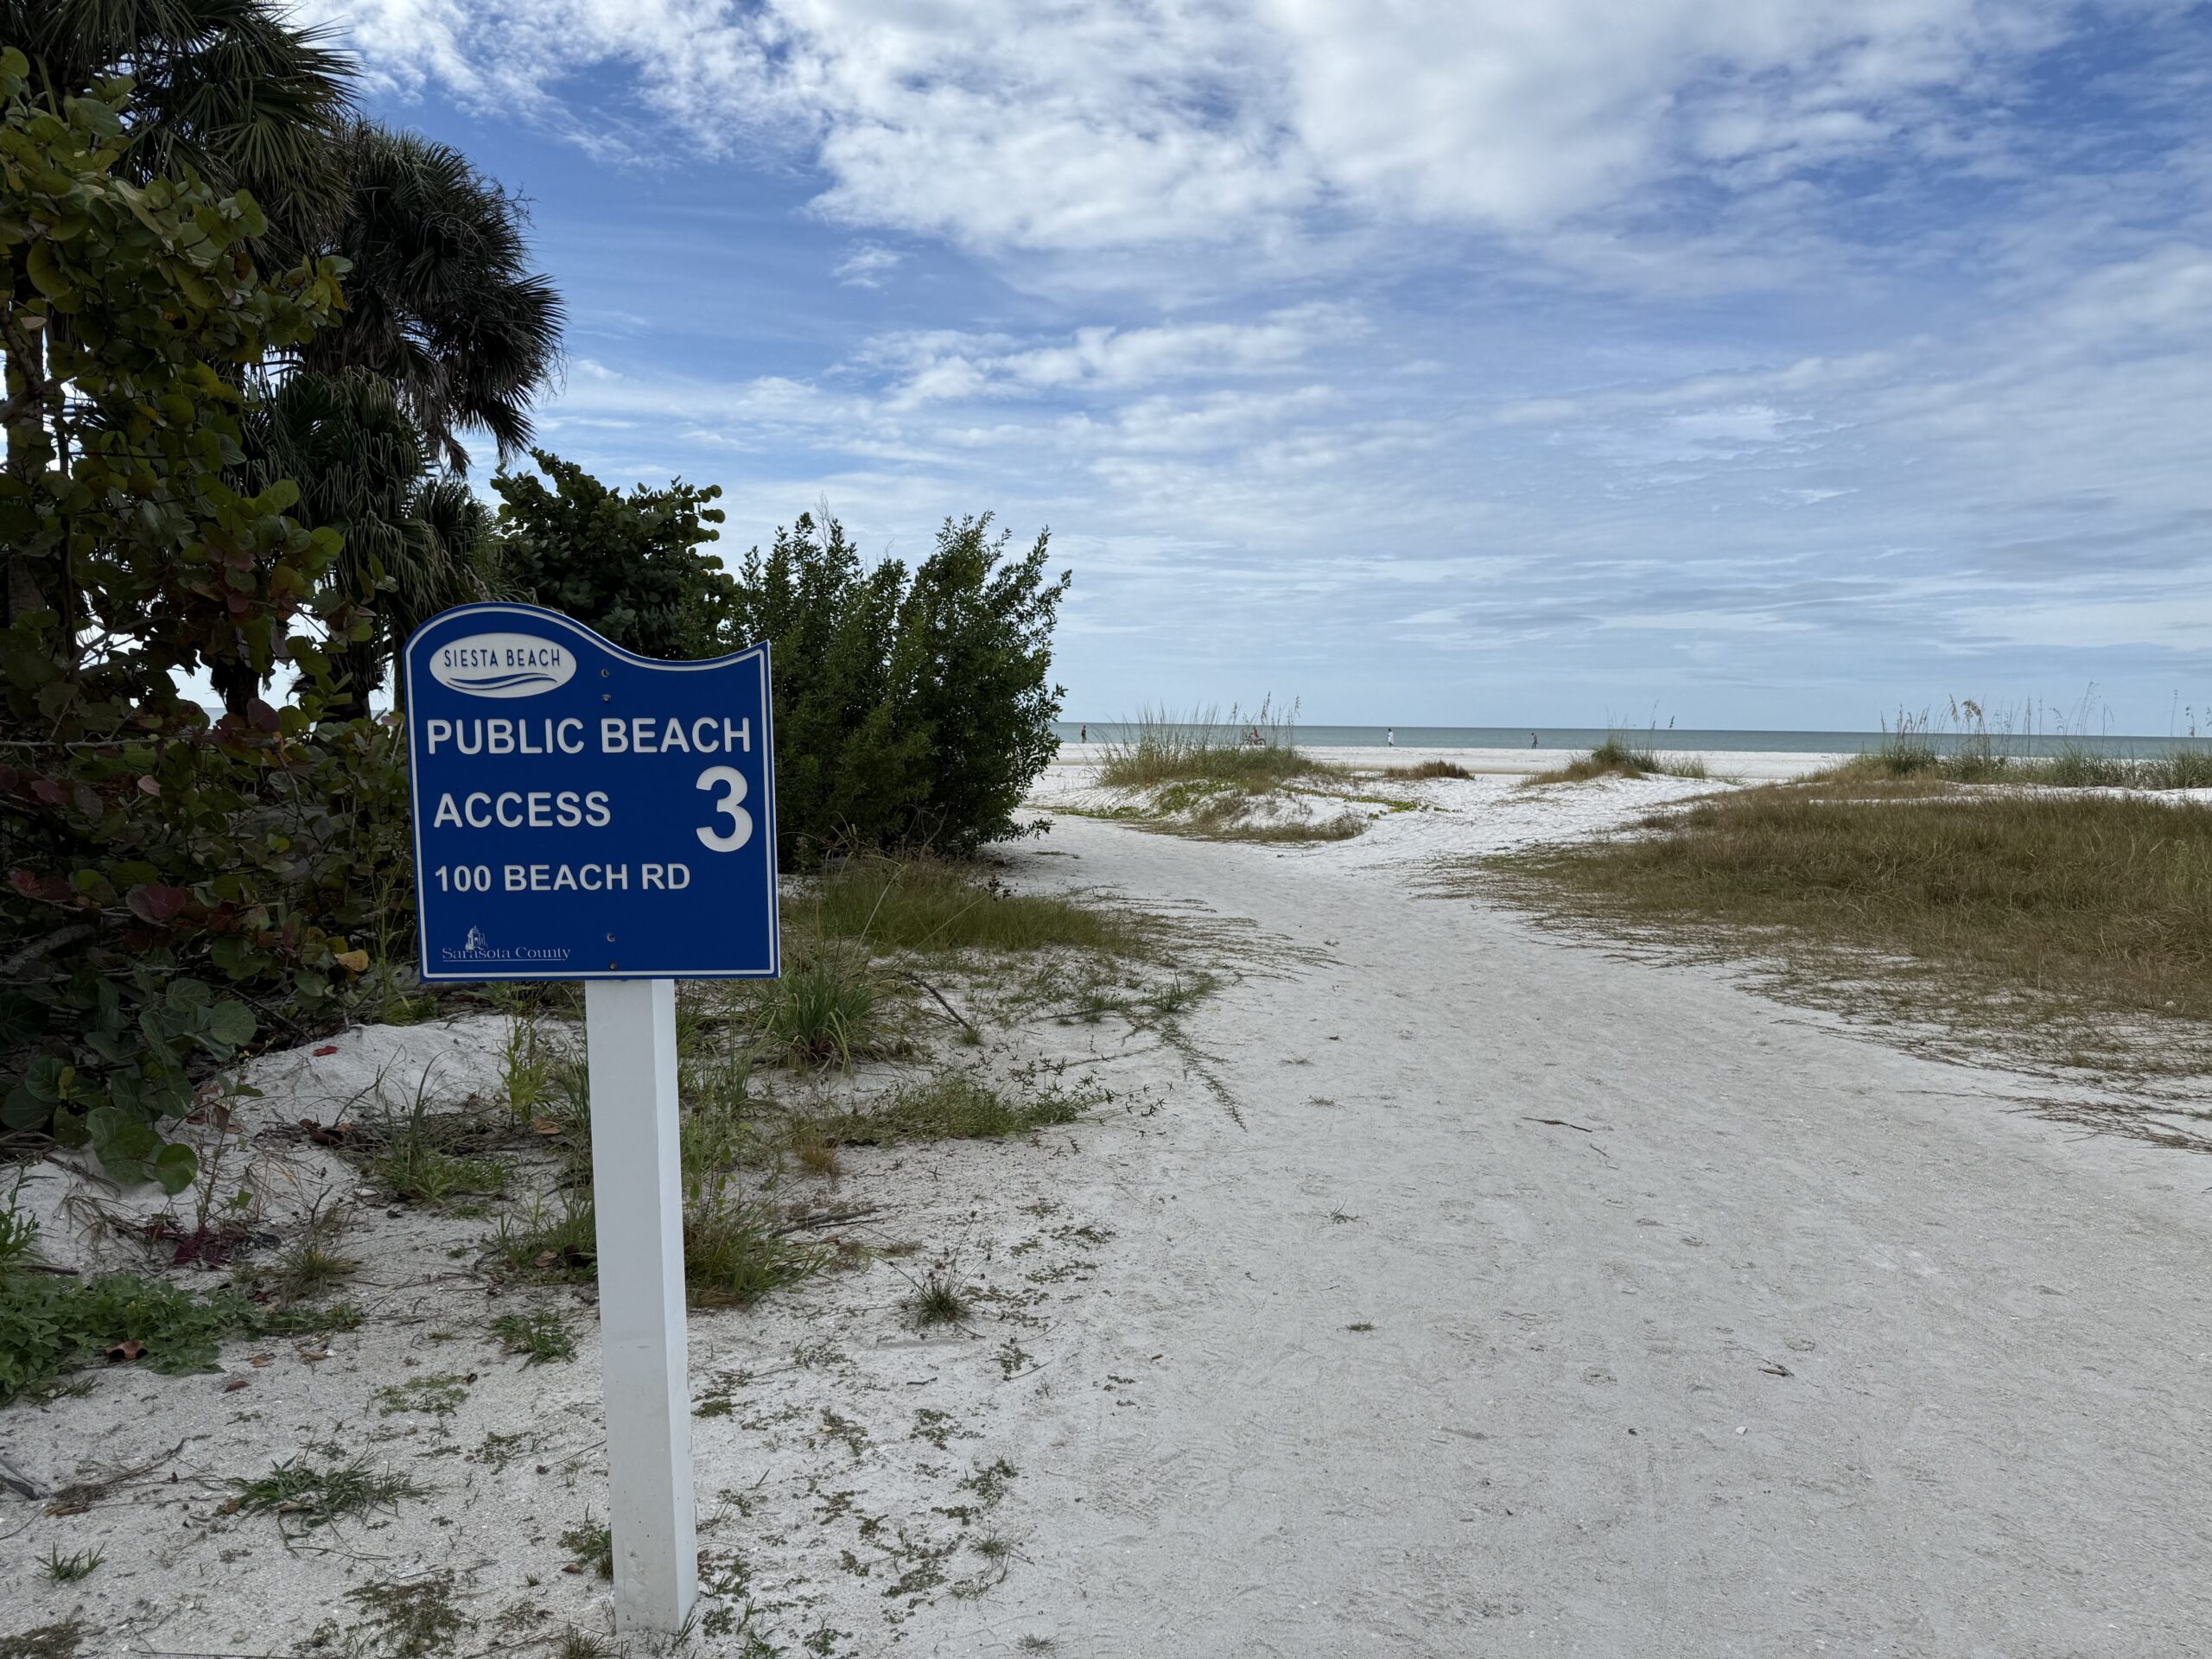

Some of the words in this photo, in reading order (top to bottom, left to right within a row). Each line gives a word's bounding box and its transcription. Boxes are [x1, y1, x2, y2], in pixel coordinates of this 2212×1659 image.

[443, 649, 499, 668] SIESTA
[506, 648, 561, 667] BEACH
[427, 717, 585, 754] PUBLIC
[601, 716, 751, 753] BEACH
[433, 791, 611, 828] ACCESS
[695, 765, 753, 853] 3
[435, 865, 492, 892] 100
[504, 864, 628, 892] BEACH
[641, 863, 690, 890] RD
[442, 947, 512, 960] Sarasota
[515, 946, 571, 962] County
